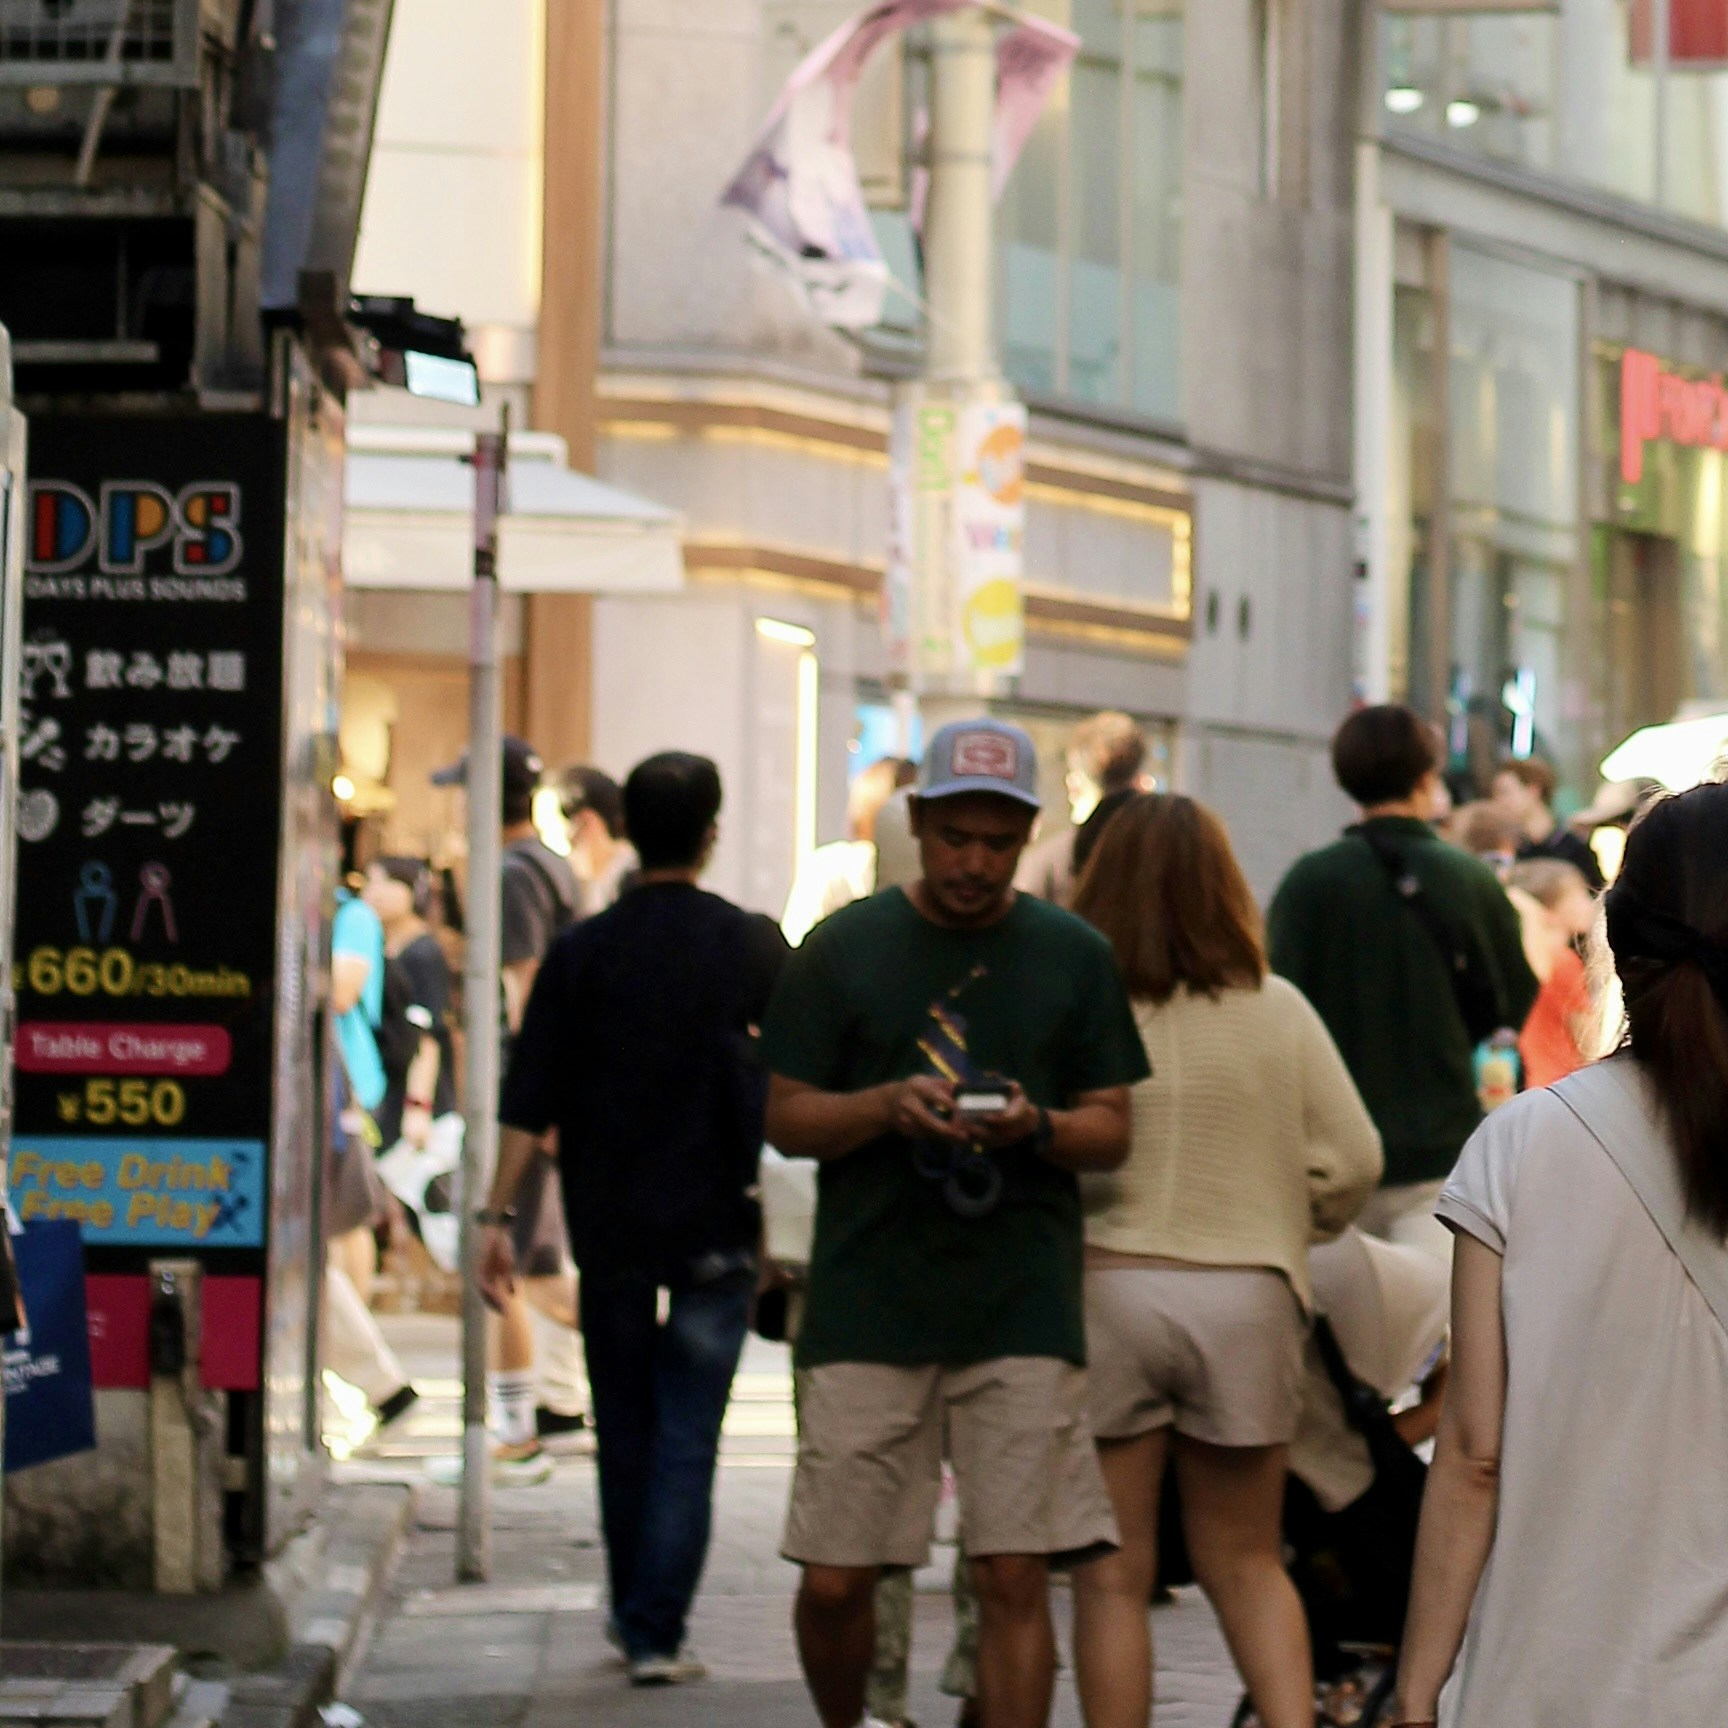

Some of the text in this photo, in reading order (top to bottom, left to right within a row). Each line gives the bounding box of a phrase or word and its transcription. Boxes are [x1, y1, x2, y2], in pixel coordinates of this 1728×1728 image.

[25, 479, 244, 575] DPS
[90, 576, 145, 601] PLUS
[149, 577, 247, 602] SOUNDS
[84, 650, 246, 692] 飲み放題
[84, 723, 243, 763] カラオケ
[81, 797, 195, 839] ダーツ
[32, 1031, 206, 1065] Table Charge
[57, 1081, 187, 1126] ¥550
[12, 1152, 231, 1191] Free Drink
[21, 1190, 221, 1239] Free Play
